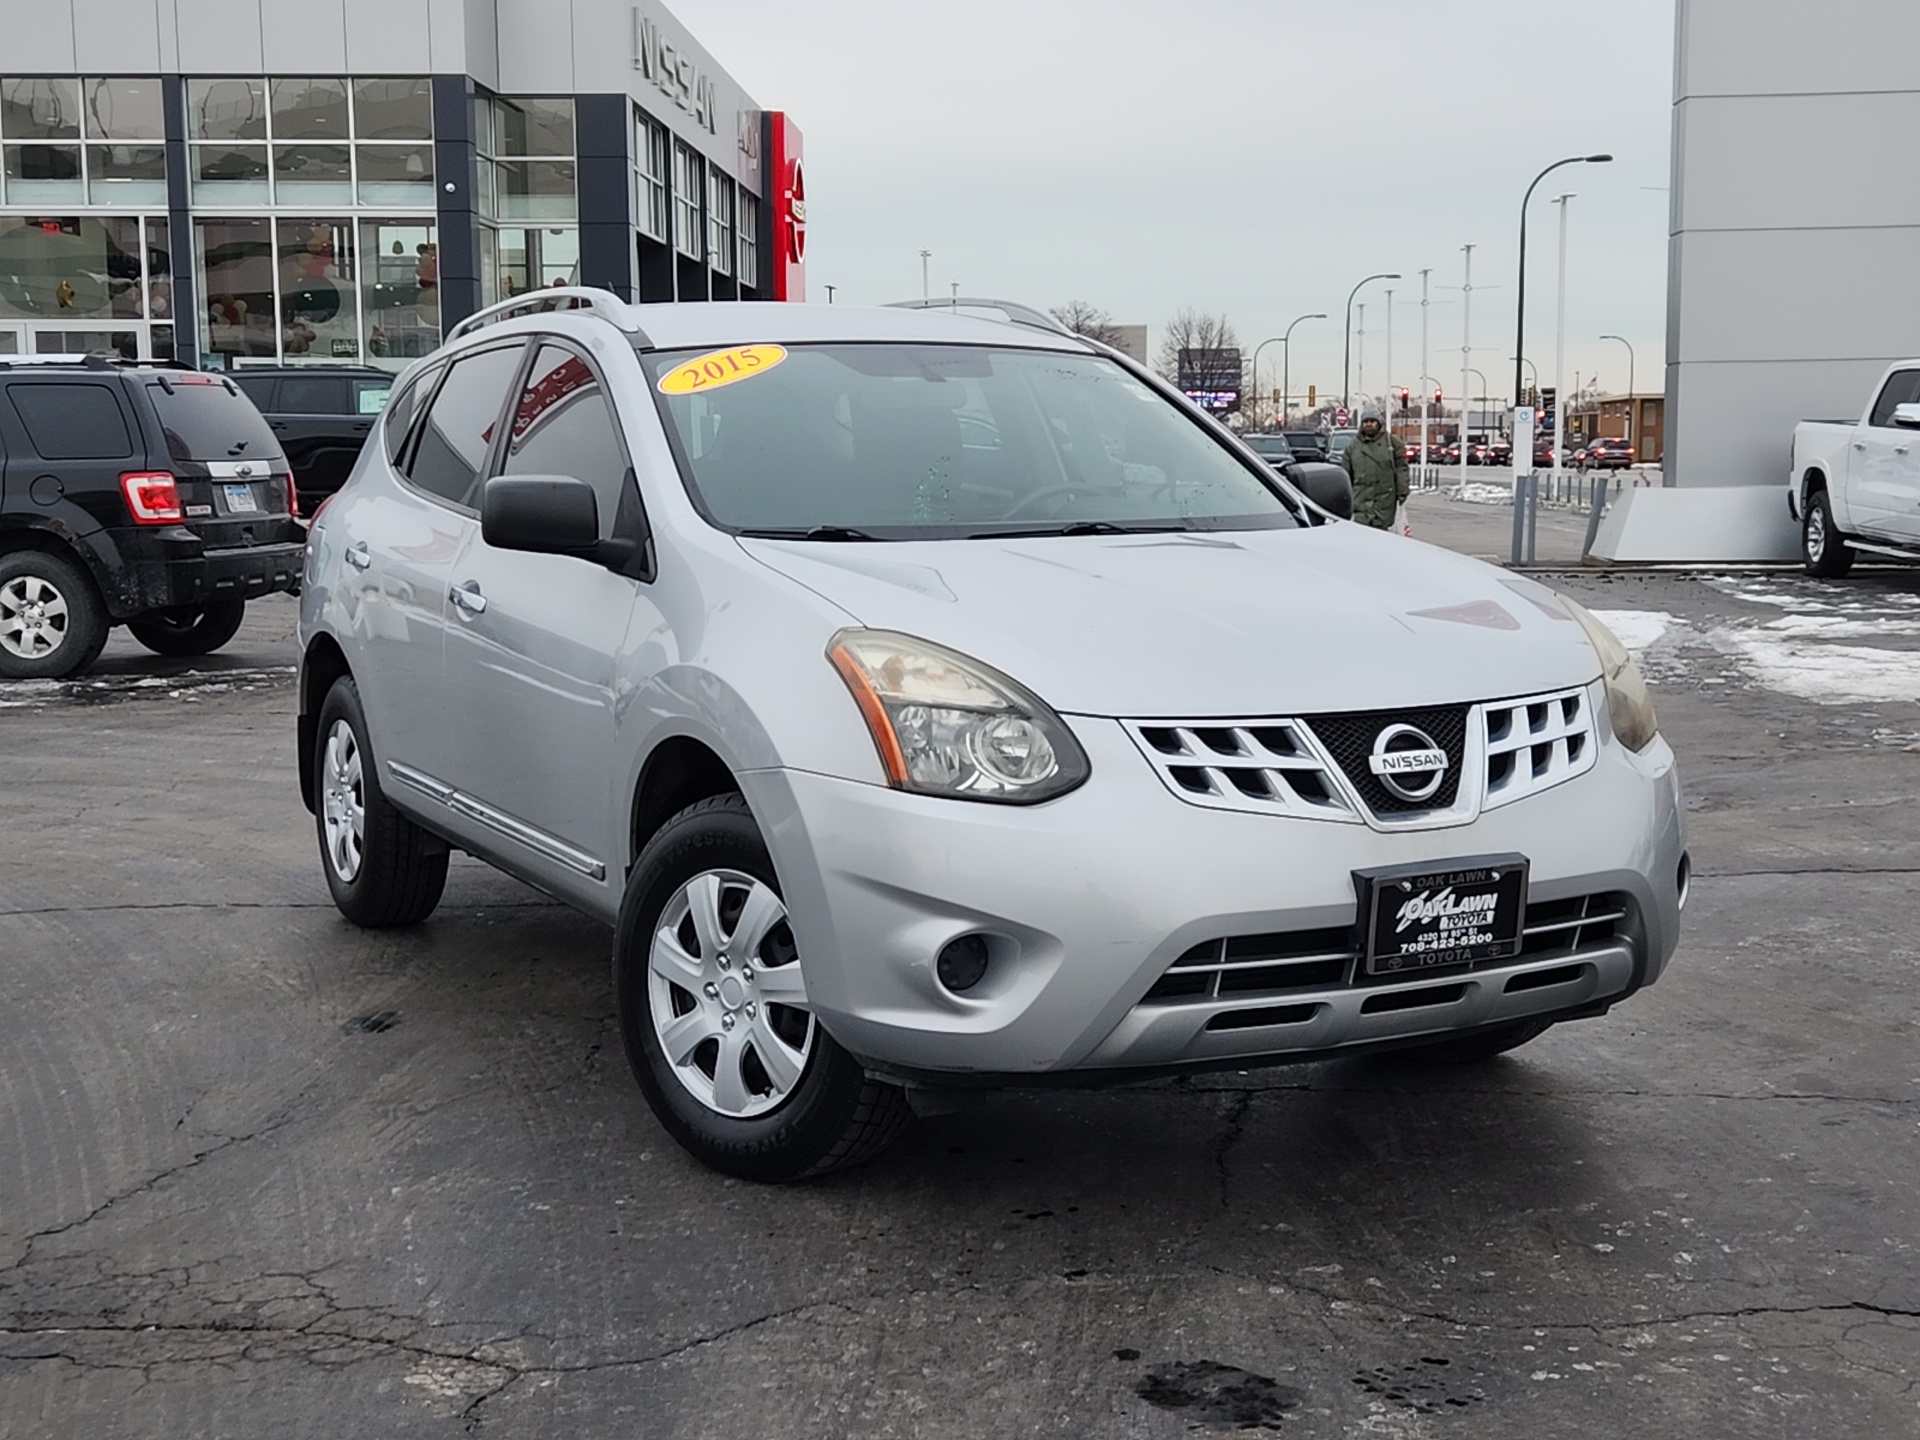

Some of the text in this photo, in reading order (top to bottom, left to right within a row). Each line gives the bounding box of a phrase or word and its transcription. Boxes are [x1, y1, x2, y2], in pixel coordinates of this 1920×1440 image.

[631, 6, 717, 135] NISSAN
[682, 349, 761, 388] 2015
[1382, 753, 1443, 769] NISSAN
[1416, 870, 1487, 888] OAK LAWN
[1417, 948, 1472, 966] TOYOTA
